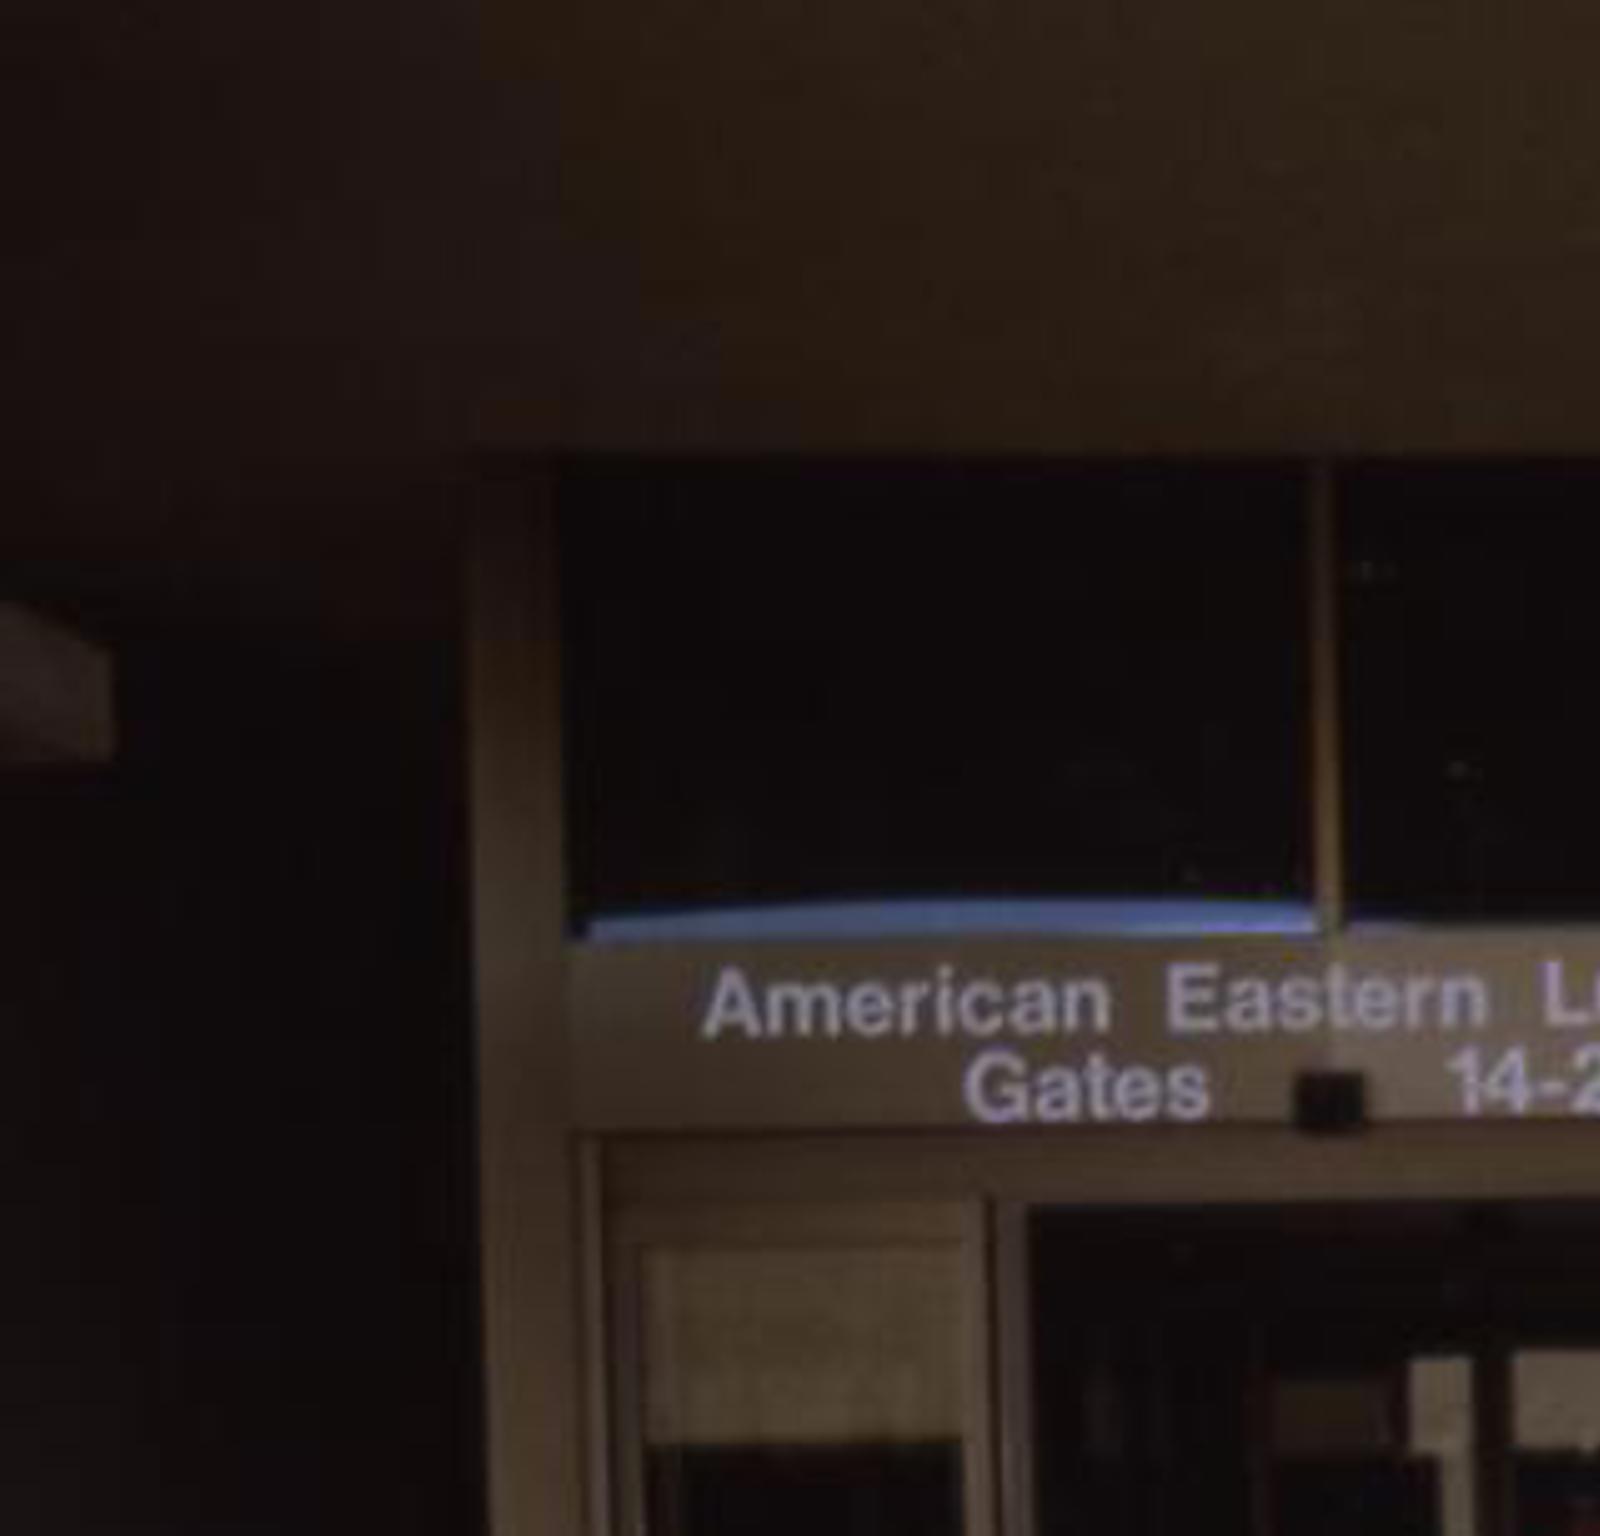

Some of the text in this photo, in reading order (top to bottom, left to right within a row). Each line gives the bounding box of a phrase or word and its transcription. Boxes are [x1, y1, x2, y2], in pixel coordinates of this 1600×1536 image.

[702, 965, 1112, 1038] American
[1164, 960, 1488, 1034] Eastern
[962, 1050, 1213, 1124] Gates
